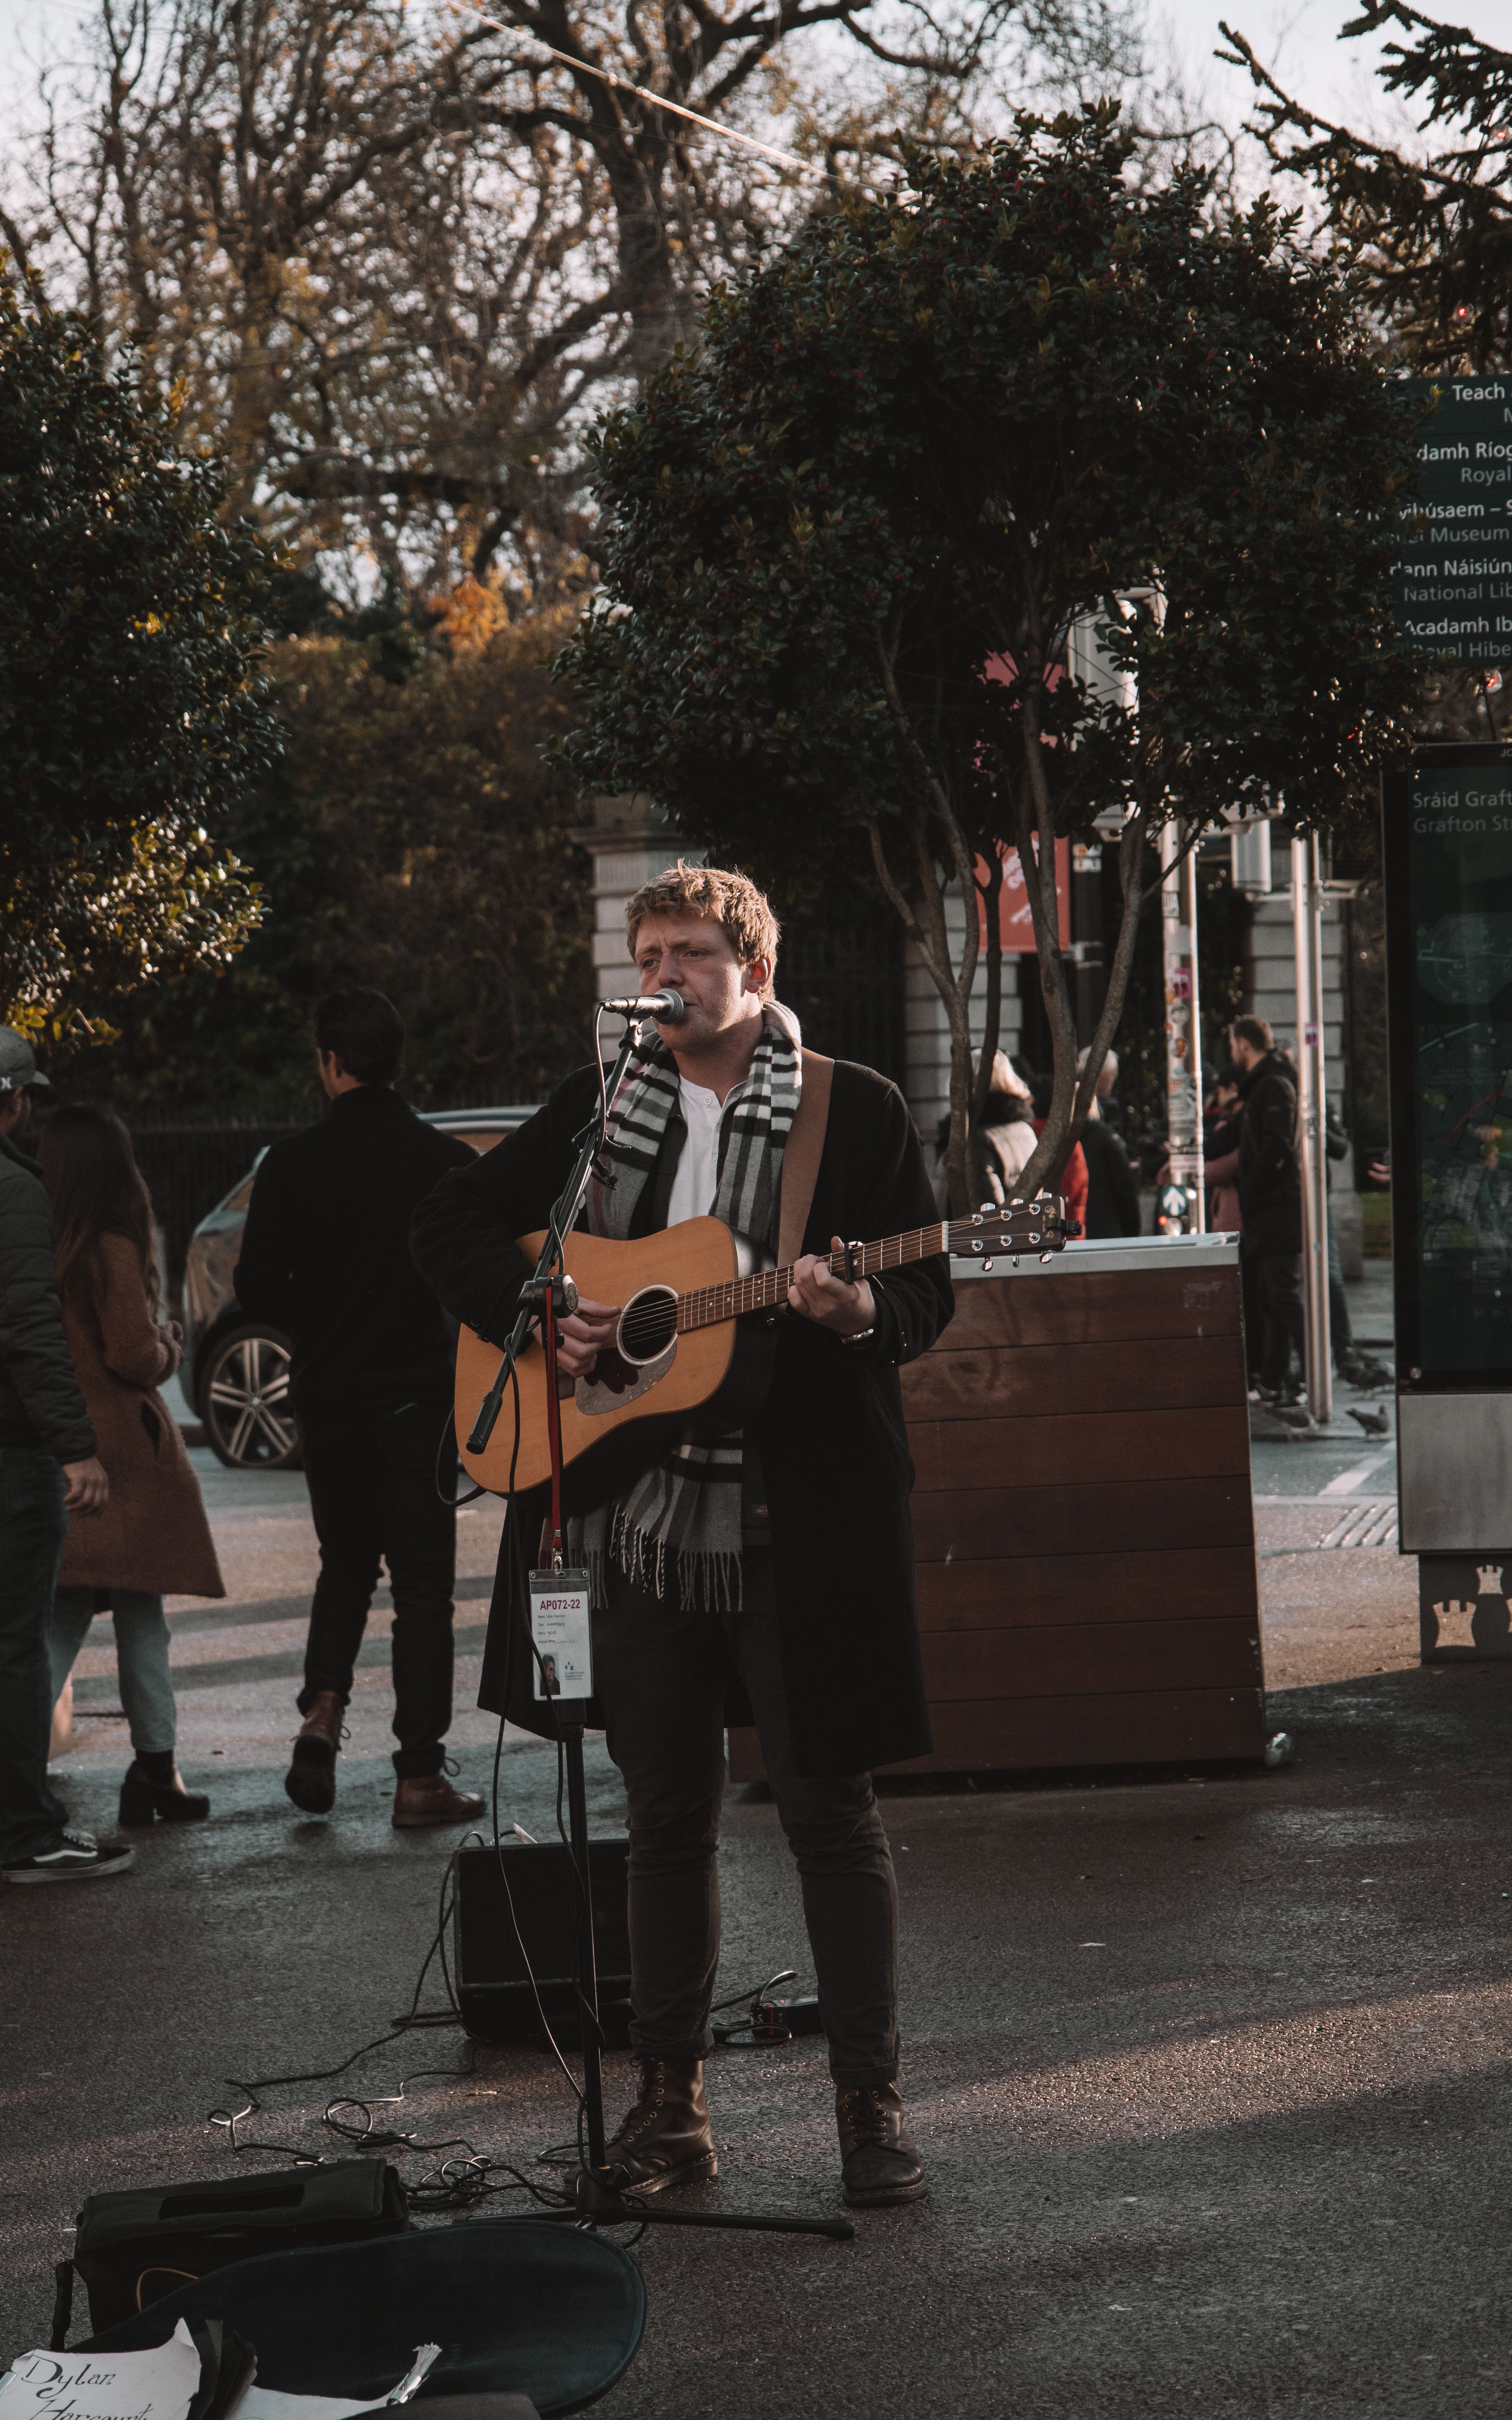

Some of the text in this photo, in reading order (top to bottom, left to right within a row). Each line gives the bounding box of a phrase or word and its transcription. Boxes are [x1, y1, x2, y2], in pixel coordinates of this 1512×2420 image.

[1452, 382, 1505, 401] Teach
[1460, 465, 1511, 486] Royal
[1431, 527, 1510, 543] Museum
[1443, 558, 1512, 576] Náisiún
[1403, 583, 1483, 602] National
[1469, 641, 1512, 657] Hibe
[1413, 790, 1459, 808] Sráid
[1413, 816, 1486, 833] Grafton
[540, 1599, 580, 1610] AP072-22
[21, 2355, 116, 2399] Dylan
